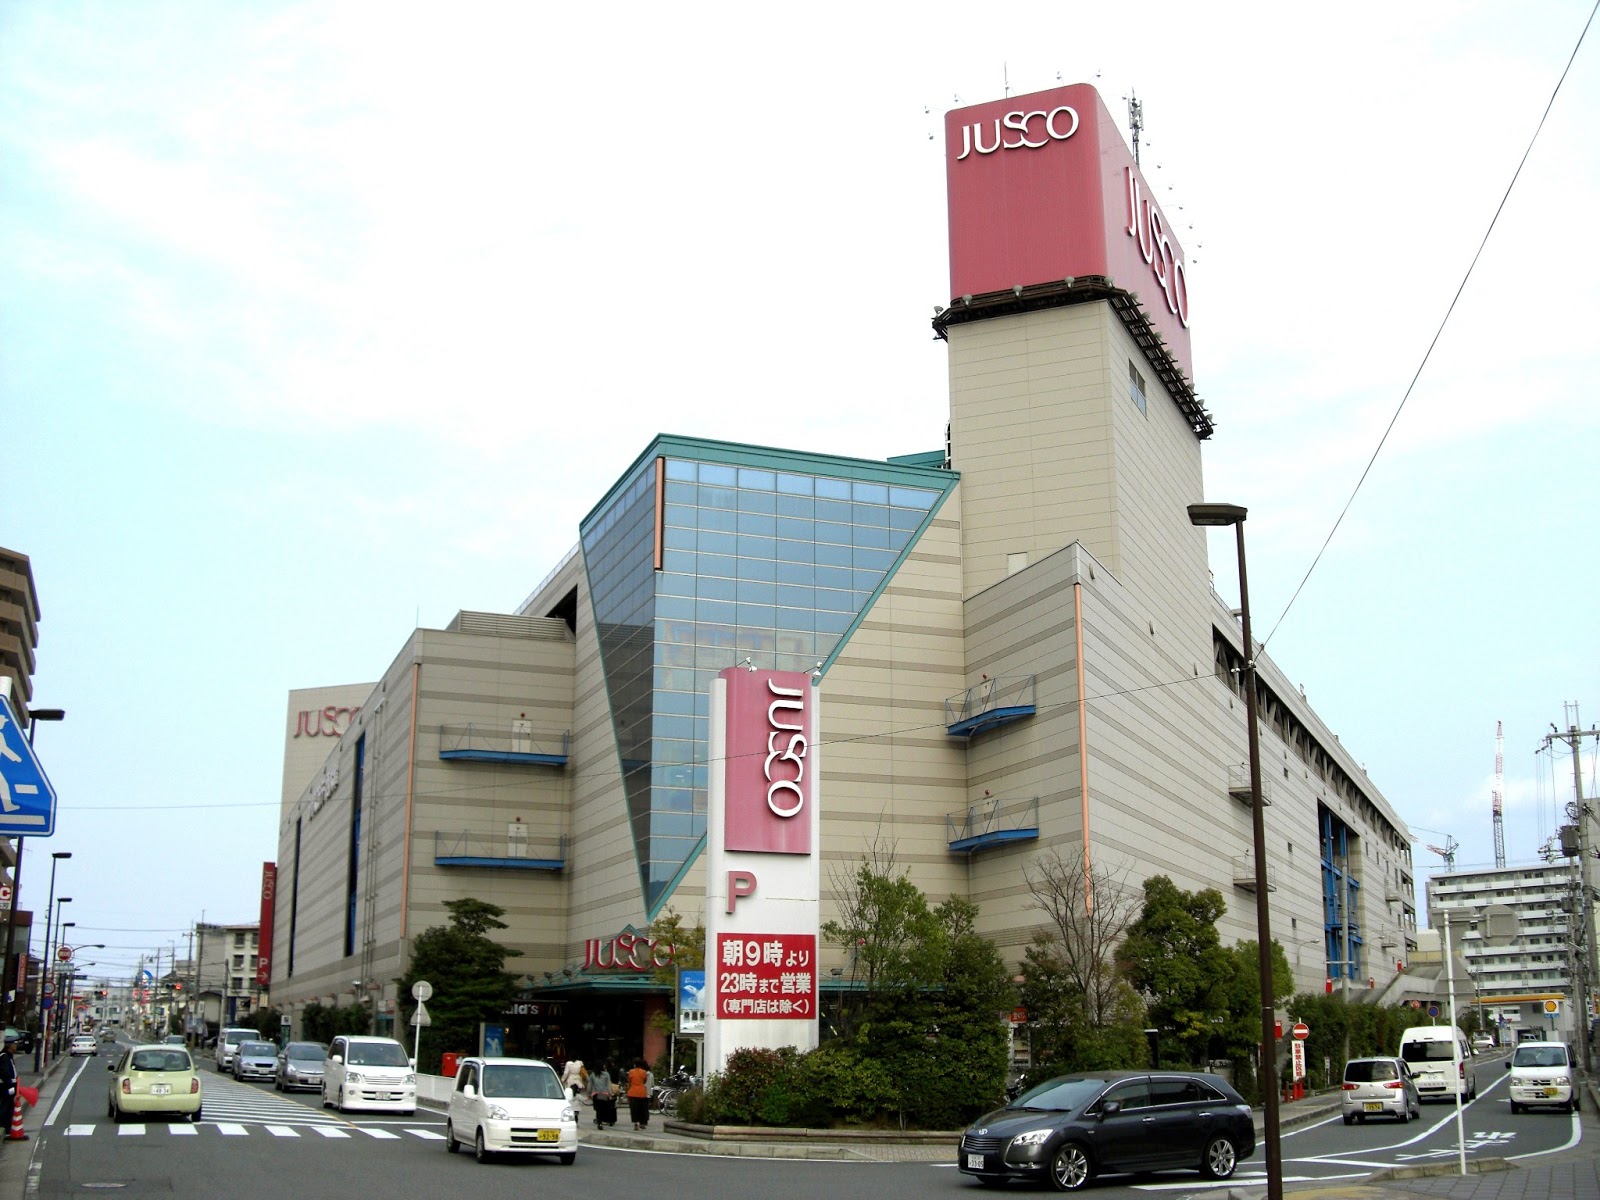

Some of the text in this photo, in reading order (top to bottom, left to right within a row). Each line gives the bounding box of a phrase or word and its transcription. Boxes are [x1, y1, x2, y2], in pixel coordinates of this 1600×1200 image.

[956, 105, 1080, 161] JUSCO
[1124, 165, 1190, 329] JUSCO
[764, 677, 807, 818] JUSCO
[262, 870, 274, 900] JUSCO
[725, 870, 758, 914] P
[259, 957, 269, 968] P
[580, 933, 676, 973] JUSCO
[722, 939, 809, 967] 朝9時より
[720, 972, 811, 995] 23時まで営業
[721, 998, 809, 1015] (専門店は除く)
